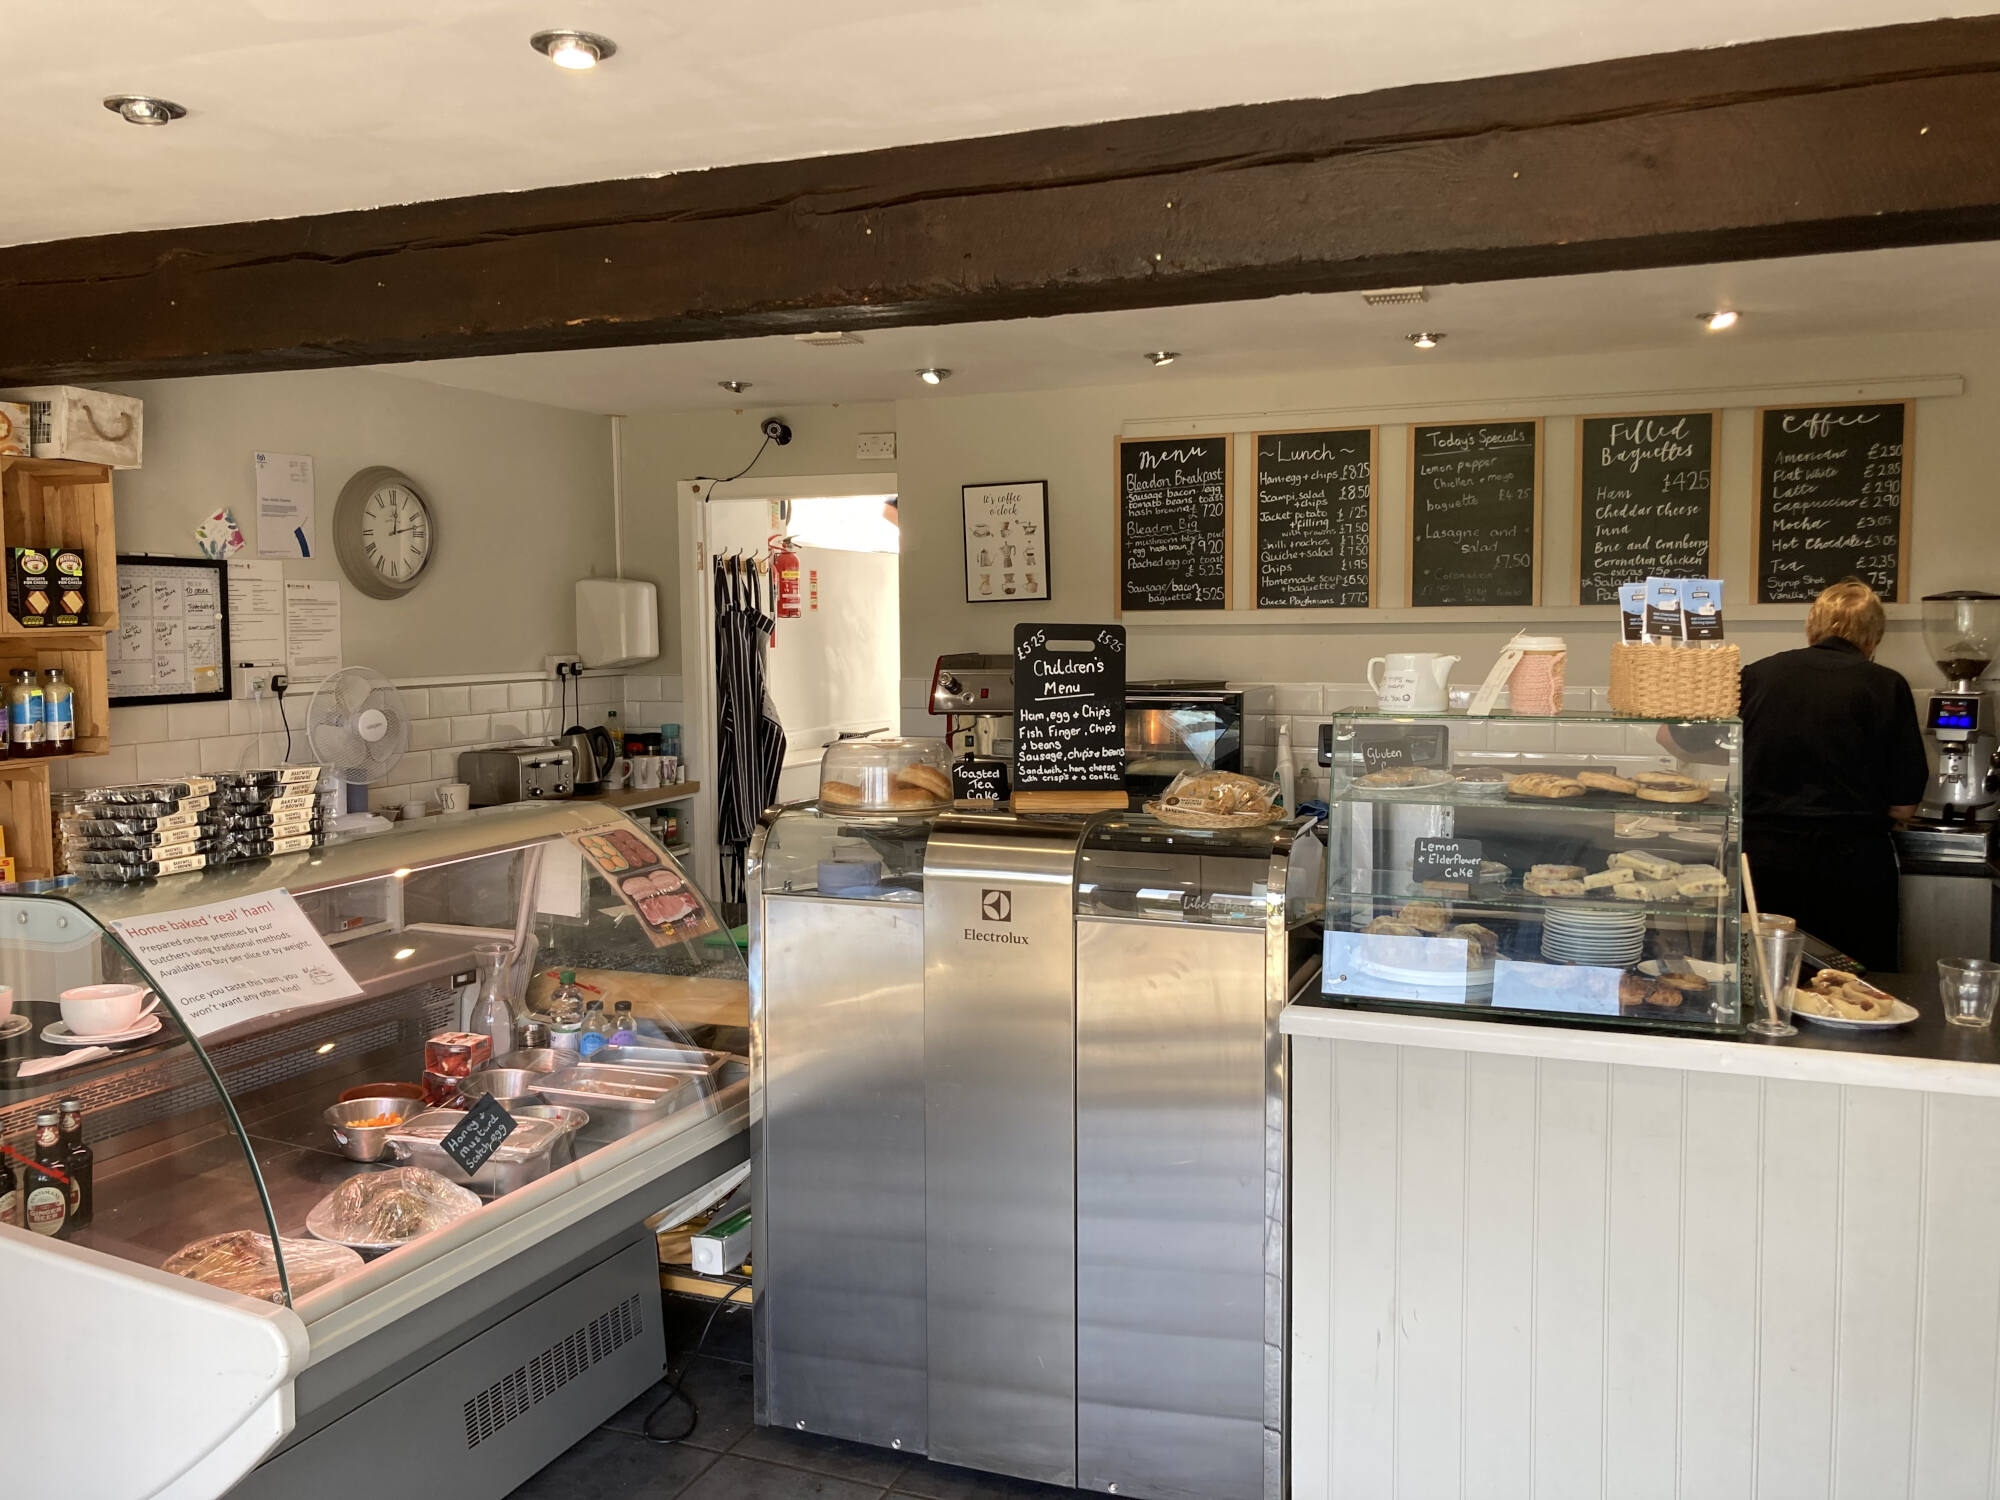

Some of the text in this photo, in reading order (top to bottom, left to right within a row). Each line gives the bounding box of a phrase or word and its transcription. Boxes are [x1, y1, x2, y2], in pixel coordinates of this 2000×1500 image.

[1609, 417, 1689, 446] Filled
[1782, 412, 1881, 439] Coffee
[1426, 431, 1475, 451] Today's
[1278, 440, 1336, 462] Lunch
[1601, 440, 1693, 473] Baguettes
[1775, 449, 1848, 465] Americano
[1311, 470, 1338, 483] chips
[1420, 464, 1453, 476] Lemon
[1773, 468, 1802, 483] Flat
[1126, 467, 1224, 491] Bleadon Breakfast
[997, 492, 1022, 505] coffee
[1167, 489, 1196, 498] bacon
[1199, 494, 1224, 503] toast
[1596, 486, 1632, 500] Ham
[1773, 484, 1820, 499] Latte
[1426, 493, 1480, 512] baguette
[1260, 509, 1328, 523] Jacket potato
[1596, 502, 1700, 519] Cheddar Cheese
[1127, 518, 1198, 536] Bleadon Big
[1773, 517, 1831, 532] Mocha
[1426, 523, 1517, 544] Lasagne and
[1461, 540, 1499, 553] salad
[1594, 533, 1709, 556] Brie and Cranberry
[1772, 538, 1800, 552] Hot
[1127, 557, 1163, 570] Poached
[1181, 557, 1196, 565] on
[1200, 555, 1224, 564] toast
[1660, 554, 1703, 566] Chicken
[1770, 559, 1806, 574] Tea
[1262, 564, 1293, 575] Chips
[1610, 567, 1643, 576] extras
[1262, 574, 1342, 587] Homemade soup
[1767, 576, 1800, 592] Syrup
[1867, 572, 1894, 589] 75p
[1148, 592, 1192, 605] baguette
[1034, 656, 1105, 677] Children's
[1044, 681, 1081, 696] Menu
[1049, 711, 1070, 723] egg
[1019, 726, 1044, 739] Fish
[1030, 740, 1062, 750] beans
[1101, 746, 1126, 757] beans
[1367, 747, 1402, 765] Gluten
[953, 765, 1000, 779] Toasted
[1088, 763, 1117, 772] cheese
[969, 778, 994, 789] Tea
[967, 789, 1000, 800] Cake
[1420, 841, 1459, 851] Lemon
[1428, 853, 1482, 865] Elderflower
[1444, 867, 1473, 878] Cake
[125, 924, 168, 938] Home
[167, 916, 208, 931] baked
[240, 901, 276, 918] ham!
[139, 922, 273, 953] Prepared on the premises by our
[964, 928, 1030, 945] Electrolux
[148, 951, 190, 966] butchers
[191, 945, 215, 956] using
[214, 938, 256, 952] traditional
[160, 961, 201, 978] Available
[201, 959, 212, 967] to
[211, 956, 229, 967] buy
[229, 954, 243, 963] per
[243, 951, 261, 960] slice
[180, 993, 206, 1006] Once
[207, 987, 225, 999] you
[224, 982, 248, 993] taste
[246, 979, 263, 988] this
[282, 973, 299, 983] you
[190, 1003, 219, 1019] won't
[219, 996, 244, 1009] want
[243, 993, 260, 1003] any
[260, 988, 281, 998] other
[447, 1120, 479, 1152] Honey
